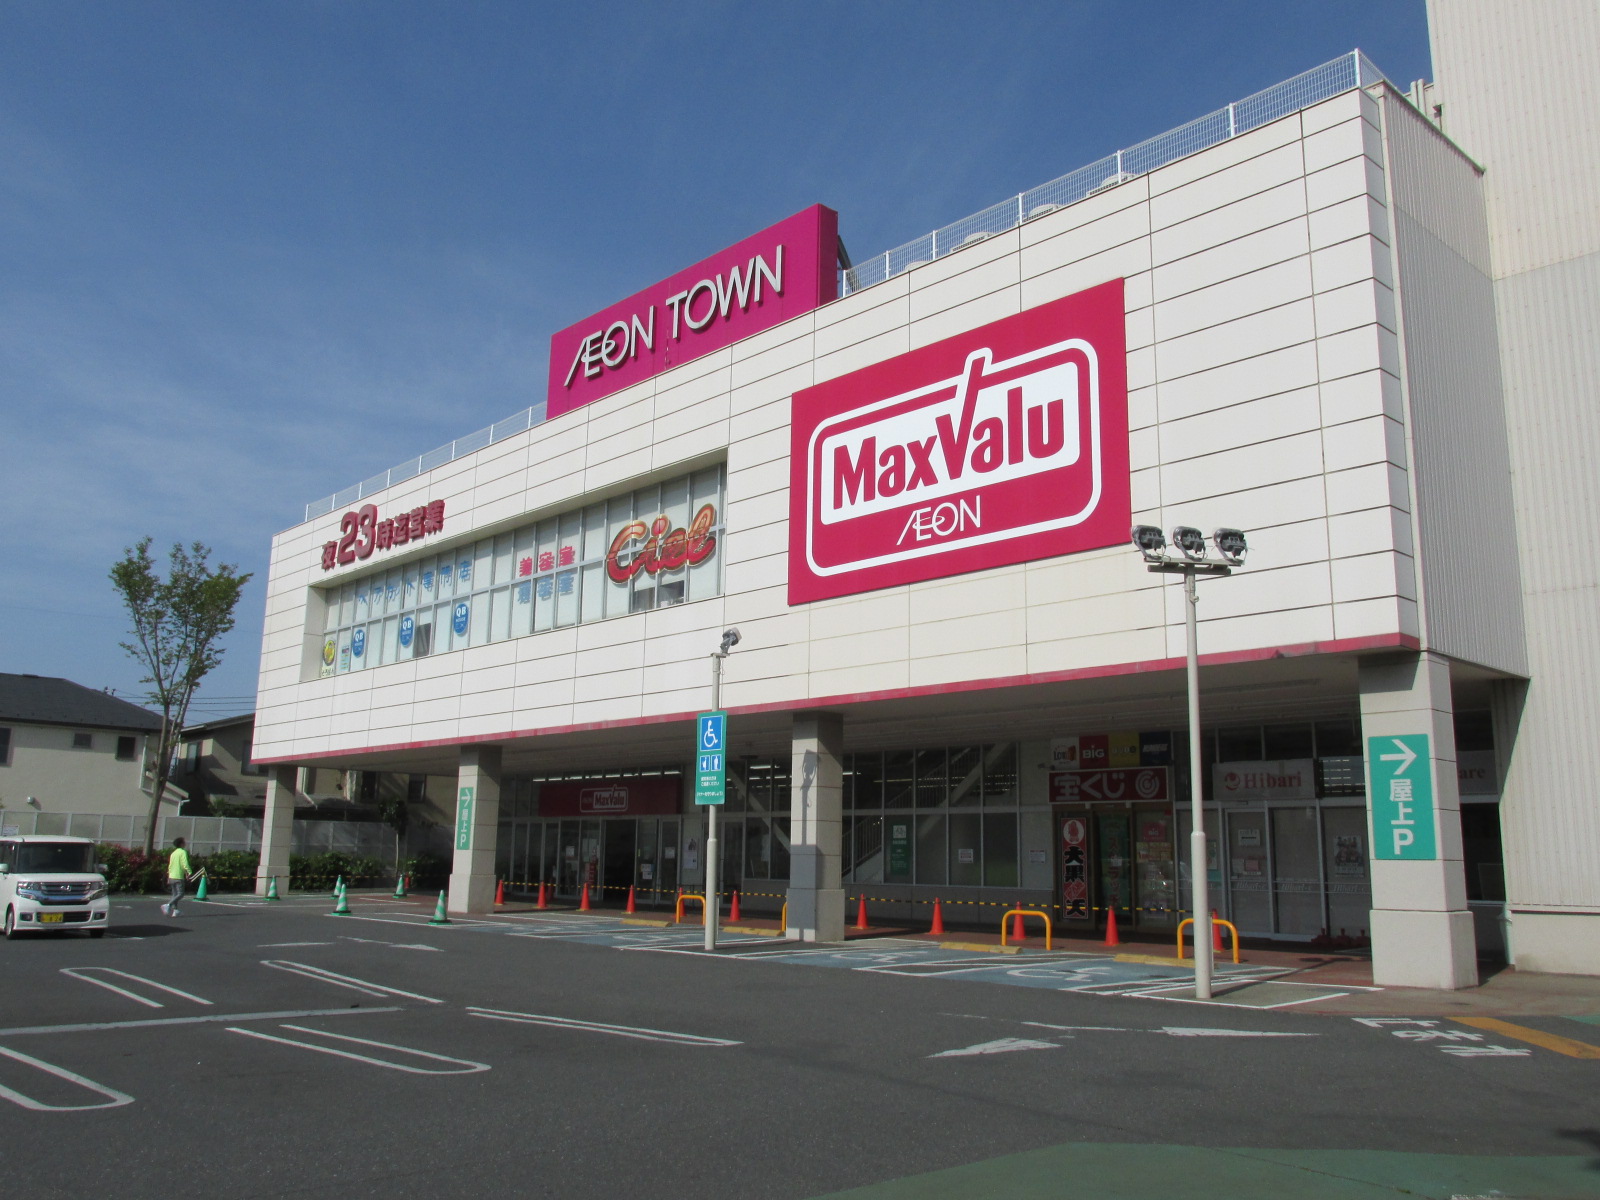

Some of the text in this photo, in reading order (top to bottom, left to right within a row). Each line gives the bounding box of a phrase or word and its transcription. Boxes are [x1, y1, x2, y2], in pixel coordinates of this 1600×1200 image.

[665, 244, 785, 341] TOWN
[832, 356, 1065, 509] MaxValu
[606, 503, 717, 584] Ciel
[456, 606, 467, 617] QB
[402, 620, 412, 630] QB
[354, 632, 364, 643] QB
[1243, 771, 1302, 789] Hibari
[1458, 766, 1486, 780] are
[1054, 771, 1126, 801] 宝くじ
[595, 787, 625, 806] MaxValu
[1389, 778, 1415, 855] 屋上P
